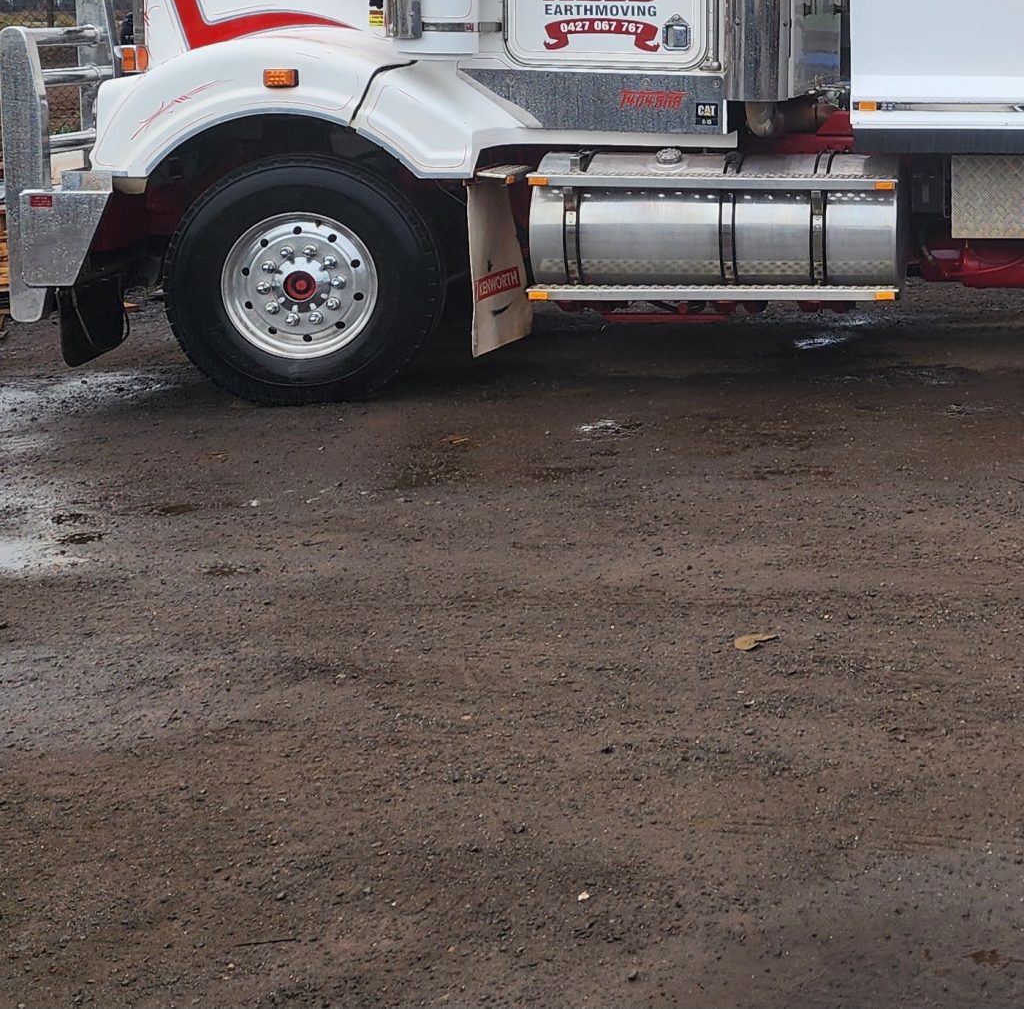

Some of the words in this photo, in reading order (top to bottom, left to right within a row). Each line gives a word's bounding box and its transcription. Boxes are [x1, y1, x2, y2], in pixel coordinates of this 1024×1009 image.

[544, 4, 657, 17] EARTHMOVING
[560, 21, 590, 33] 0427
[594, 21, 616, 31] 067
[621, 22, 644, 34] 767
[698, 105, 716, 116] CAT
